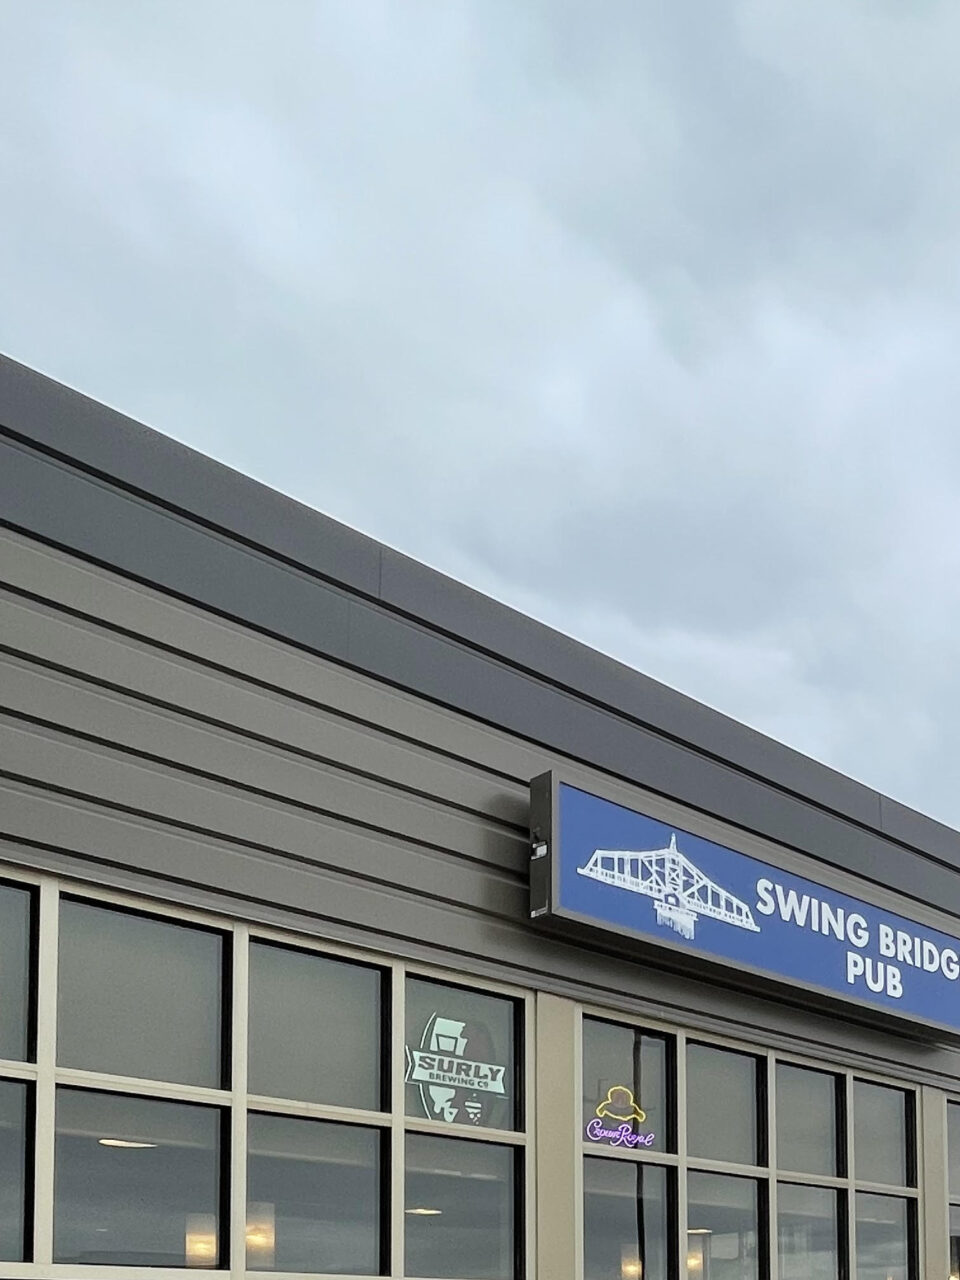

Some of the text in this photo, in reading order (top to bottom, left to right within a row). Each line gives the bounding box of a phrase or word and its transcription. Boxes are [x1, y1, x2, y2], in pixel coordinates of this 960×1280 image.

[755, 878, 870, 949] SWING
[846, 952, 904, 999] PUB
[418, 1056, 502, 1082] SURLY
[428, 1072, 475, 1088] BREWING
